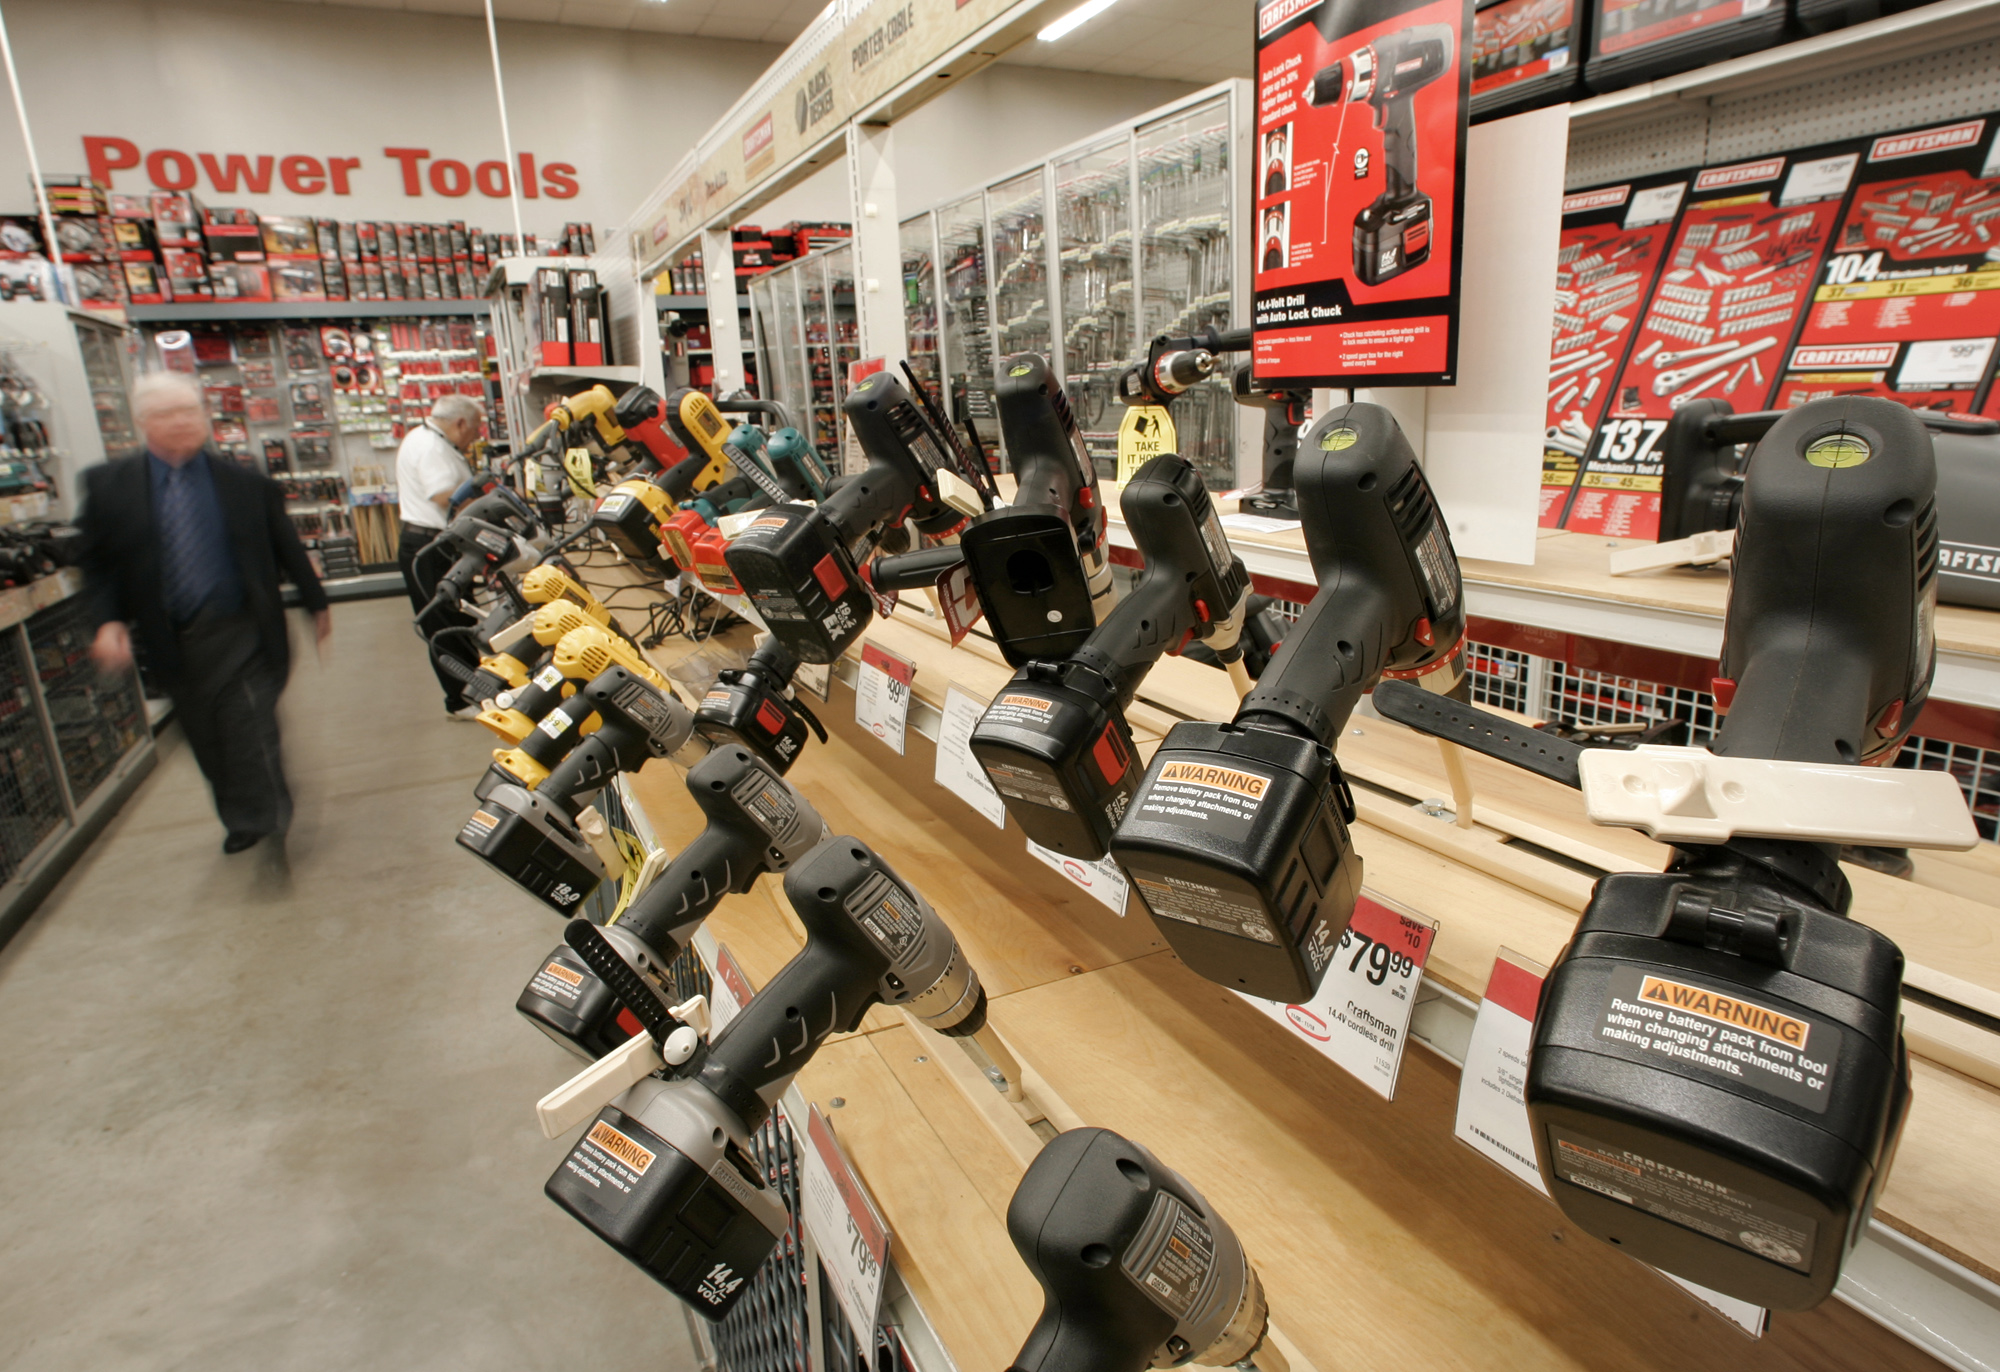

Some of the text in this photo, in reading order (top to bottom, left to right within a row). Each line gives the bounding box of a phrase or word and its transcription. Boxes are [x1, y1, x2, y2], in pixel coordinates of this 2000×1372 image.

[810, 88, 834, 127] DECKER
[1876, 128, 1976, 157] CRAFTSMAN
[81, 136, 580, 199] Power Tools
[1700, 163, 1777, 188] CRAFTSMAN
[1825, 252, 1884, 285] 104
[1890, 269, 1933, 279] Mechanics
[1933, 266, 1950, 276] Tool
[1952, 264, 1968, 273] Set
[1827, 276, 1974, 298] 37 31 36
[1256, 304, 1342, 325] with Auto Lock Chuck
[1257, 294, 1305, 312] 14.4-Volt Drill
[1797, 348, 1889, 365] CRAFTSMAN
[1135, 441, 1160, 452] TAKE
[1597, 420, 1668, 461] 137
[1648, 451, 1663, 462] PC
[1127, 454, 1136, 464] IT
[1587, 461, 1655, 475] Mechanics Tool
[1588, 475, 1634, 488] 35 45
[1939, 548, 2000, 574] AFTS
[823, 613, 846, 642] EX
[1011, 696, 1049, 710] WARNING
[1179, 765, 1263, 795] WARNING
[1153, 783, 1259, 810] Remove battery pack from tool
[1165, 795, 1197, 808] changing
[1197, 801, 1241, 817] attachments
[1142, 804, 1209, 820] making adjustments.
[554, 882, 581, 902] 18.0
[1164, 876, 1217, 894] CRAFTSMAN
[550, 892, 569, 906] VOLT
[1314, 919, 1335, 963] 14.4
[1405, 930, 1420, 949] $10
[1308, 941, 1322, 972] VOLT
[1347, 1000, 1397, 1040] Craftsman
[1672, 986, 1801, 1043] WARNING
[1328, 1006, 1395, 1053] 14.4V cordless drill
[1610, 998, 1828, 1076] Remove battery pack from tool
[1502, 1050, 1520, 1065] speeds
[1602, 1026, 1744, 1077] making adjustments.
[1606, 1012, 1825, 1091] when changing attachments or
[1509, 1072, 1524, 1086] single
[599, 1128, 650, 1170] WARNING
[1598, 1148, 1656, 1173] BATTERY
[597, 1167, 625, 1190] attachments
[623, 1186, 631, 1194] or
[605, 1158, 617, 1170] pack
[616, 1164, 628, 1177] from
[627, 1172, 639, 1185] tool
[714, 1166, 750, 1201] CRAFTSMAN
[1622, 1151, 1728, 1195] CRAFTSMAN
[706, 1262, 744, 1294] 14.4
[697, 1284, 723, 1305] VOLT
